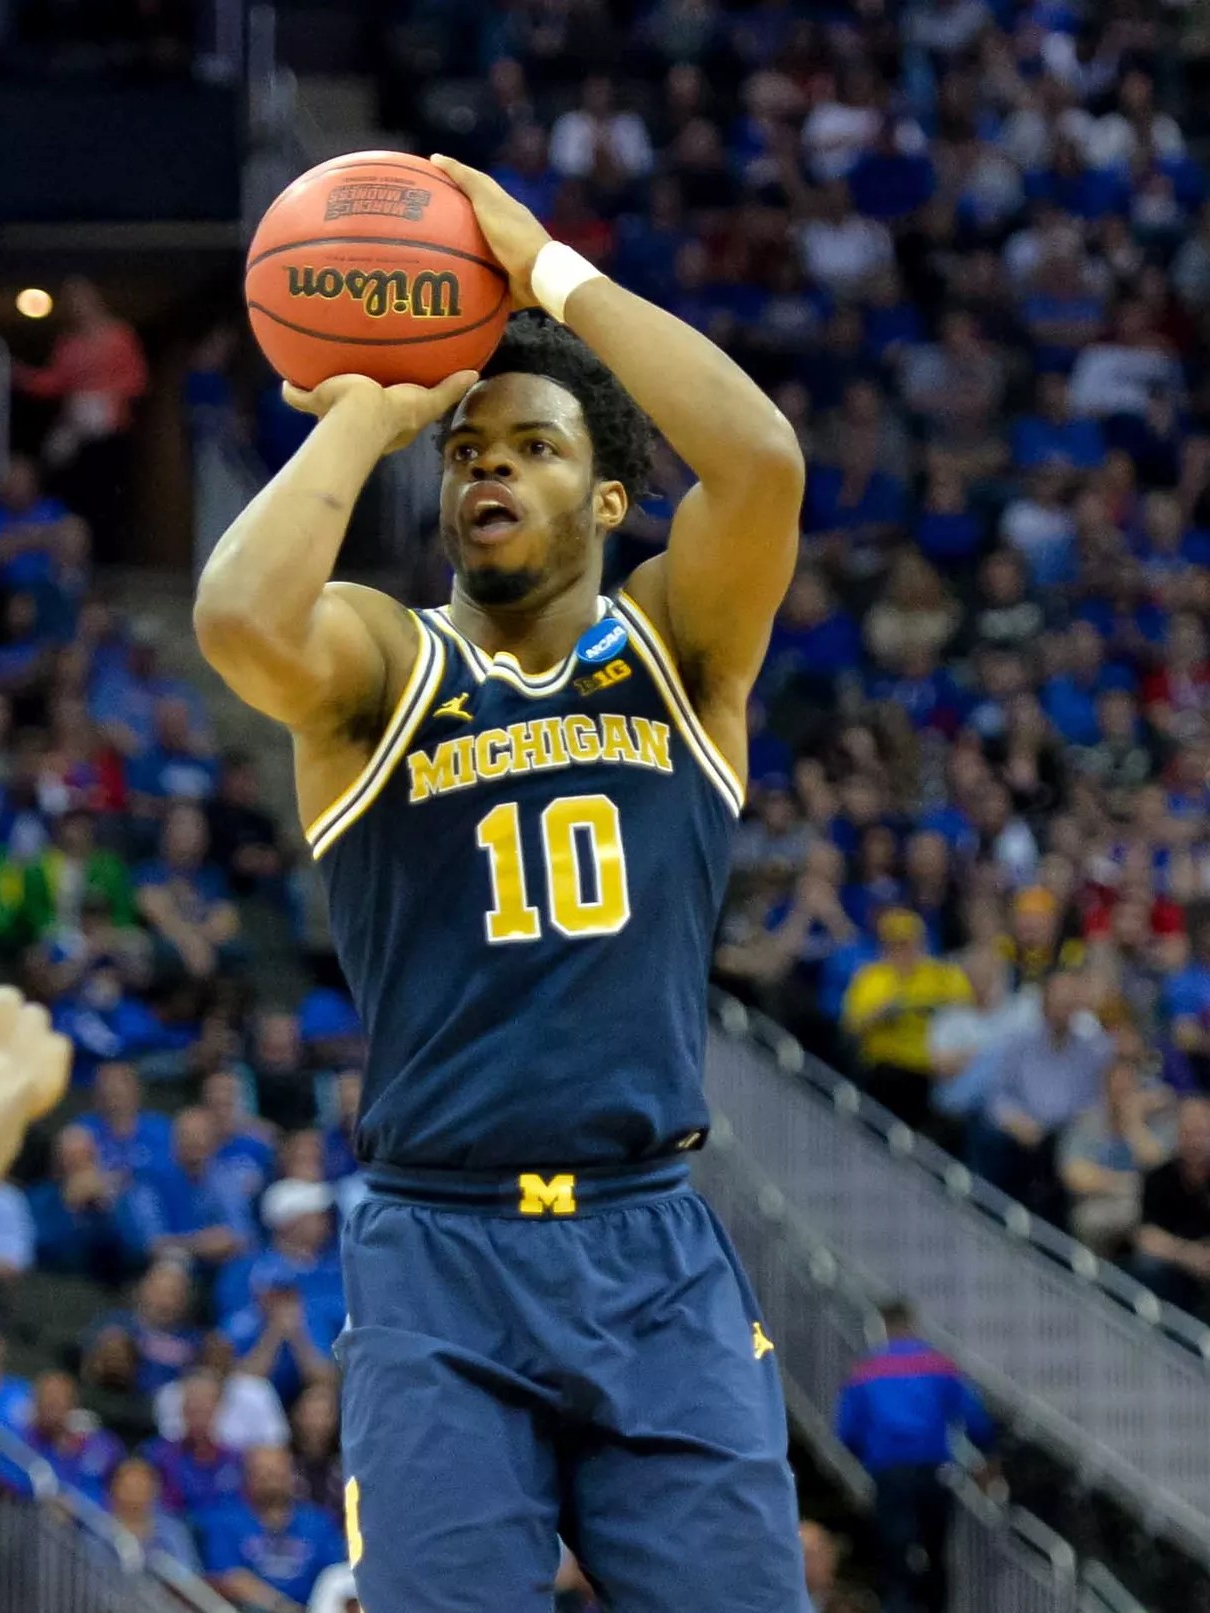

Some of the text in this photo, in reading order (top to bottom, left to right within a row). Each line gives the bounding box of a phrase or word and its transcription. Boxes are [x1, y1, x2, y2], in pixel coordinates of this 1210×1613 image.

[284, 266, 462, 318] Wilson
[585, 625, 626, 659] NCAA
[407, 714, 673, 804] MICHIGAN
[477, 794, 631, 943] 10
[519, 1174, 576, 1213] M
